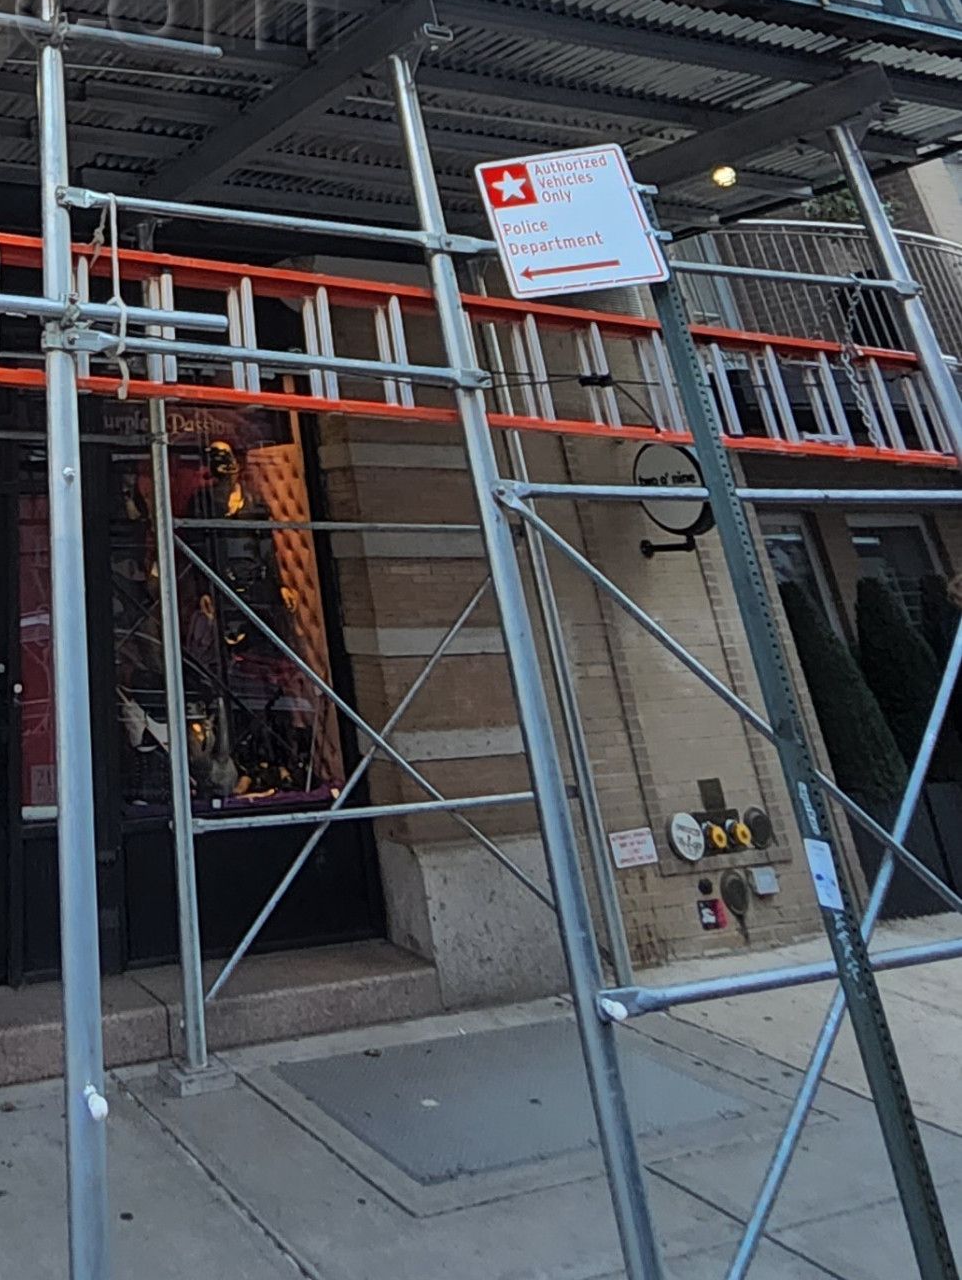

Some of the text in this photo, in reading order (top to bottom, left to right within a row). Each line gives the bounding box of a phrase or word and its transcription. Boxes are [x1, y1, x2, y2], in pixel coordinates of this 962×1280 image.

[534, 154, 607, 176] Authorized
[538, 171, 594, 189] Vehicles
[541, 188, 572, 203] Only
[502, 219, 549, 236] Police
[508, 231, 604, 256] Department
[671, 471, 697, 484] nine
